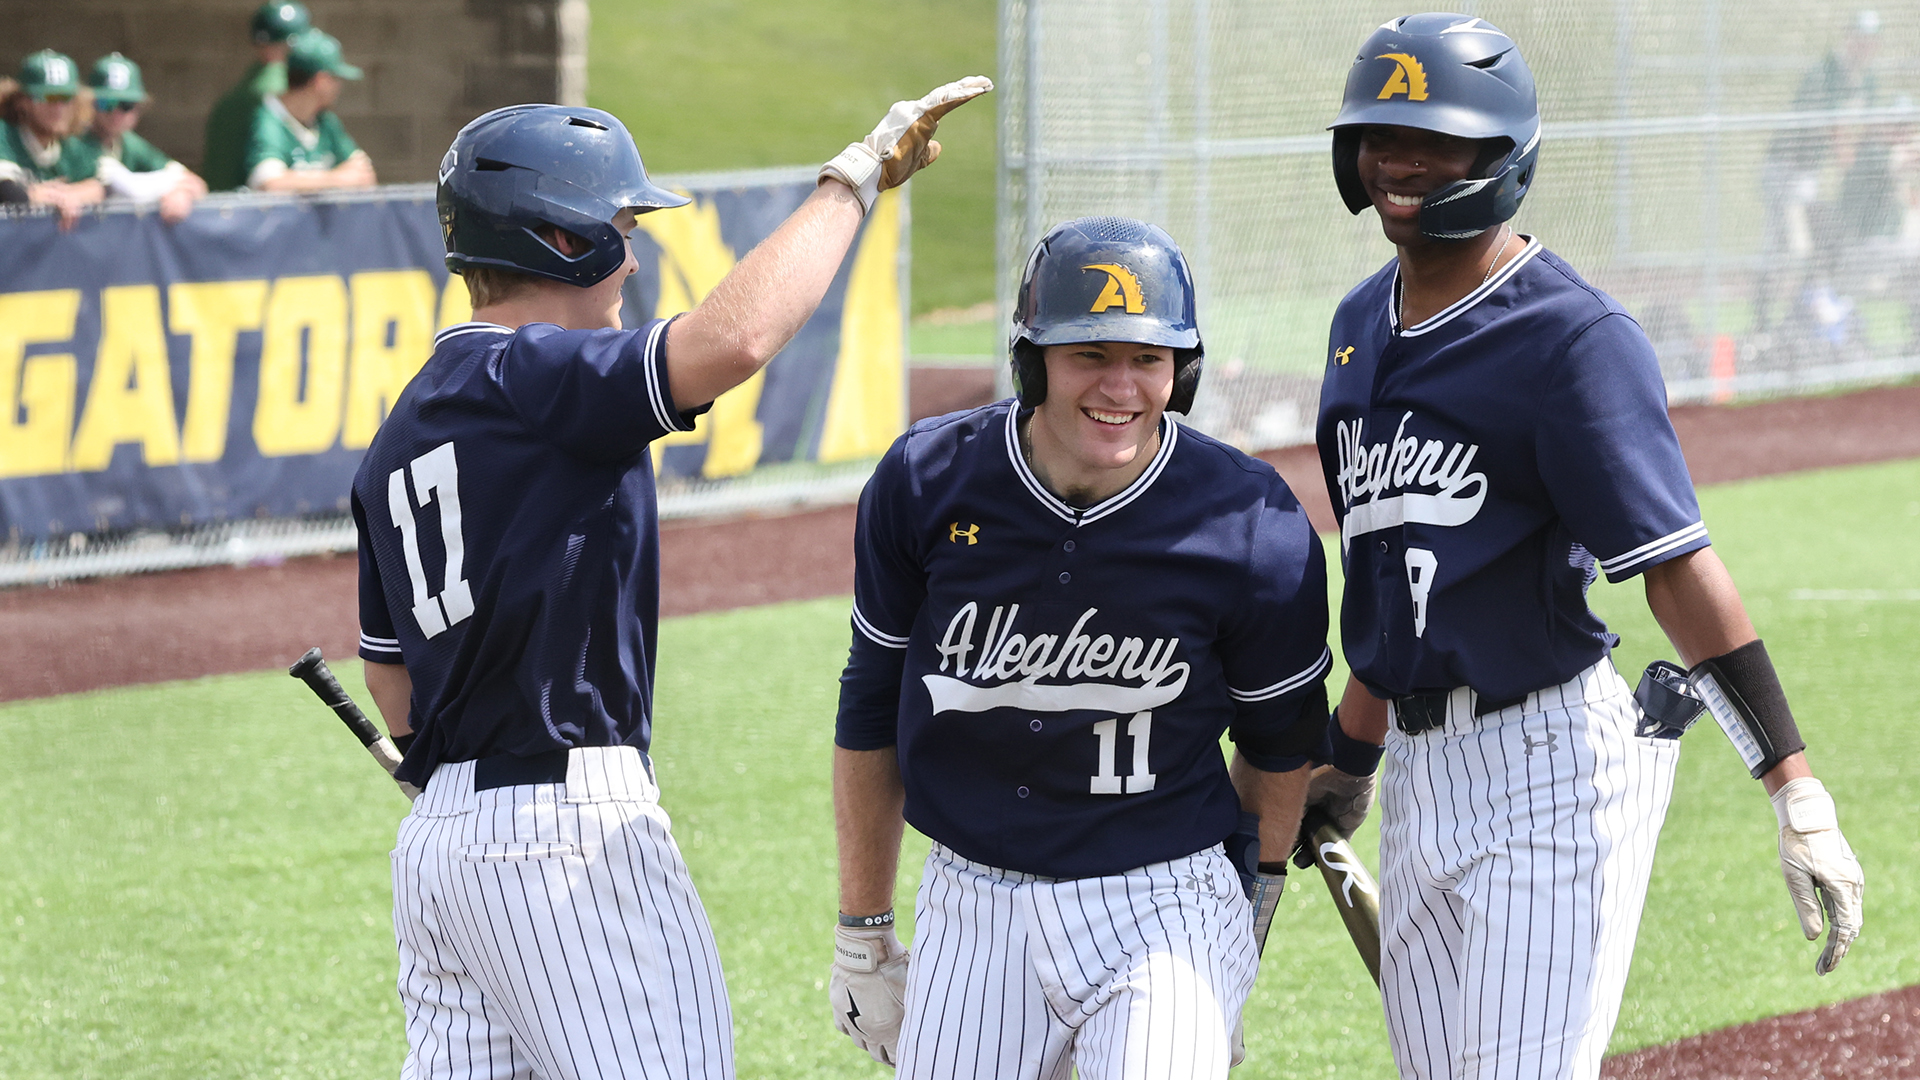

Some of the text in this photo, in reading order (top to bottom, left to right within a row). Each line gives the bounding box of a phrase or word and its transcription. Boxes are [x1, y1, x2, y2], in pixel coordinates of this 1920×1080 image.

[0, 269, 473, 479] GATOR
[1336, 410, 1489, 512] Allegheny
[387, 441, 476, 640] 17
[935, 600, 1191, 694] Allegheny
[1089, 711, 1157, 795] 11
